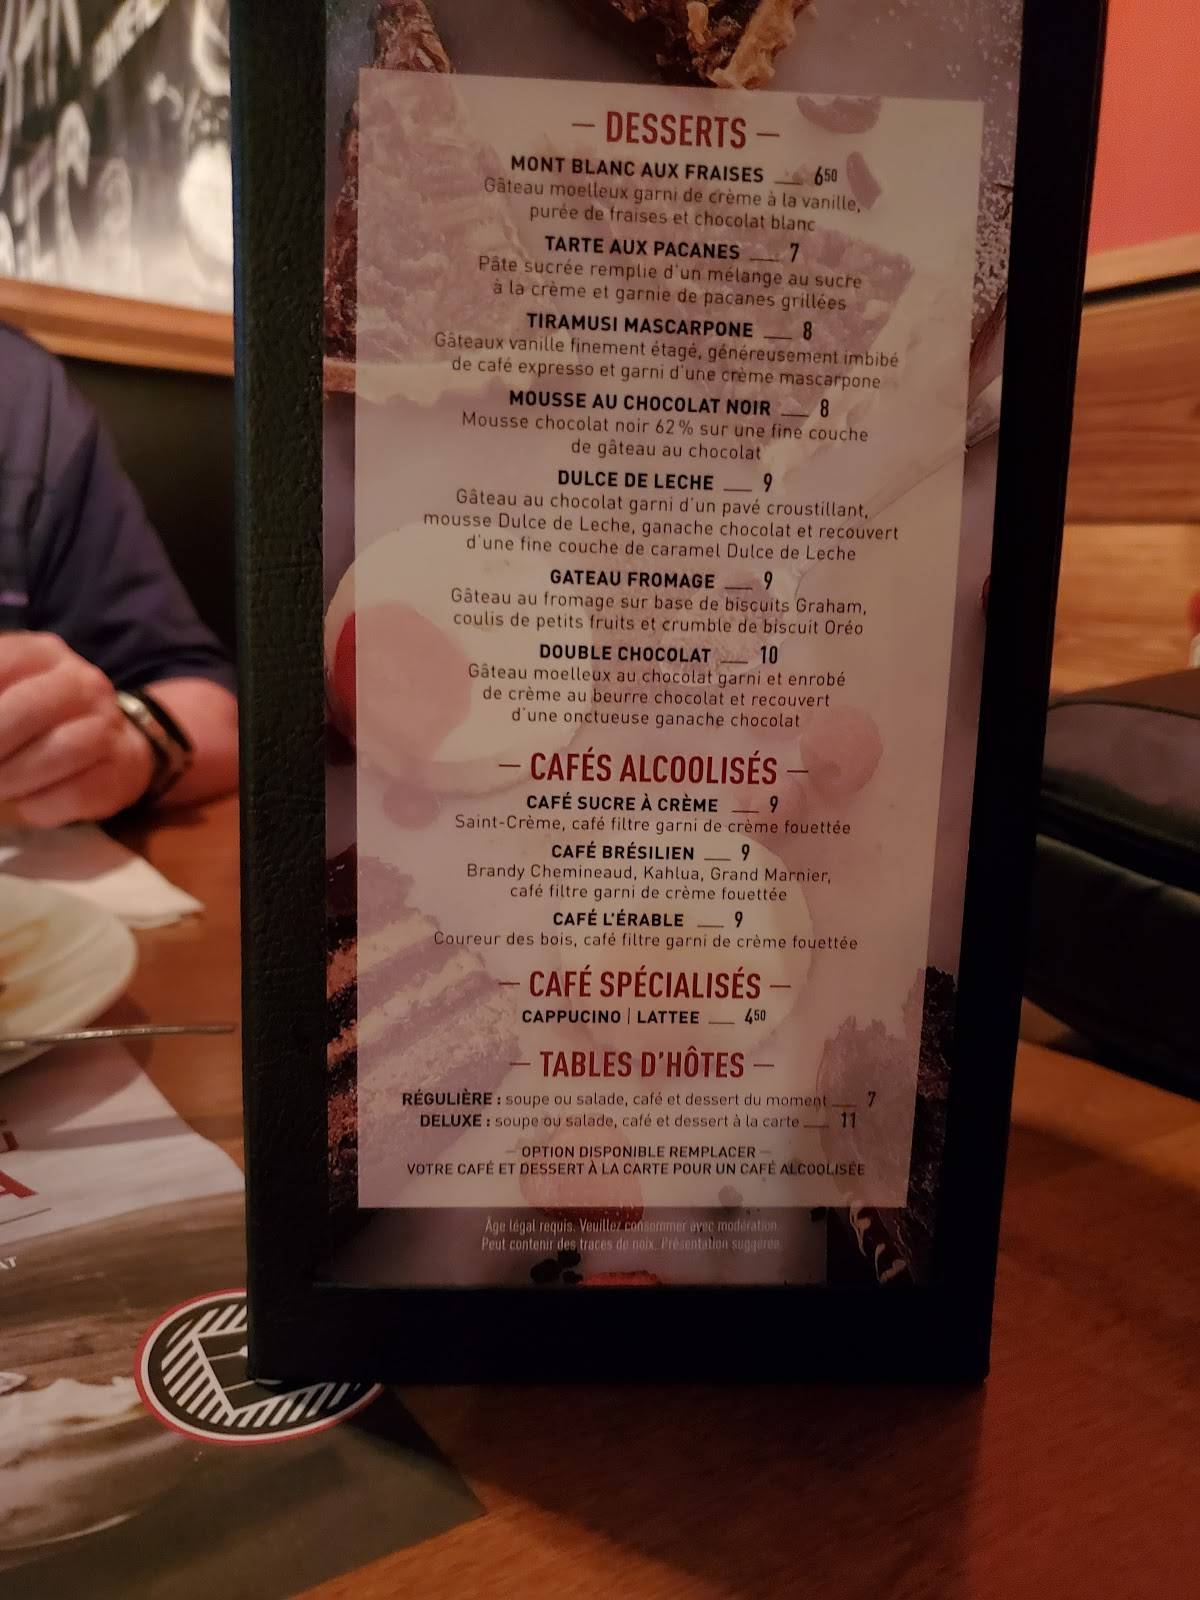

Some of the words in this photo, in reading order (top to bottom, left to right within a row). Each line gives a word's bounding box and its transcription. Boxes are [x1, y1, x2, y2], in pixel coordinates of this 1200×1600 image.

[605, 111, 748, 150] DESSERTS
[510, 155, 566, 174] MONT
[571, 158, 636, 178] BLANC
[641, 161, 679, 180] AUX
[685, 164, 765, 184] FRAISES
[479, 175, 544, 195] Gâteau
[549, 181, 629, 200] moelleux
[631, 187, 678, 205] garni
[682, 186, 703, 203] de
[708, 188, 762, 207] crème
[767, 190, 777, 207] à
[782, 191, 797, 209] la
[801, 194, 861, 213] vanille,
[544, 235, 606, 255] TARTE
[609, 239, 648, 257] AUX
[653, 241, 741, 261] PACANES
[789, 243, 801, 263] 7
[477, 254, 520, 273] Pâte
[523, 258, 584, 277] sucrée
[590, 263, 658, 281] remplie
[663, 264, 702, 280] d'un
[707, 267, 783, 288] mélange
[787, 272, 809, 287] au
[814, 274, 863, 290] sucre
[529, 312, 618, 332] TIRAMUSI
[624, 317, 754, 338] MASCARPONE
[802, 320, 813, 341] 8
[434, 330, 504, 350] Gâteaux
[508, 336, 565, 353] vanille
[570, 337, 646, 356] finement
[650, 341, 703, 362] étagé,
[707, 344, 839, 364] généreusement
[843, 351, 899, 368] imbibé
[507, 390, 587, 408] MOUSSE
[591, 392, 618, 410] AU
[623, 395, 721, 414] CHOCOLAT
[725, 398, 772, 416] NOIR
[820, 397, 830, 419] 8
[557, 470, 619, 487] DULCE
[623, 472, 649, 489] DE
[653, 474, 715, 491] LECHE
[763, 471, 773, 493] 9
[456, 488, 517, 506] Gâteau
[523, 494, 544, 508] au
[550, 492, 623, 510] chocolat
[628, 497, 673, 515] garni
[679, 496, 716, 514] d'un
[722, 499, 761, 517] pavé
[766, 501, 869, 518] croustillant,
[550, 569, 621, 586] GATEAU
[627, 573, 716, 590] FROMAGE
[763, 569, 773, 591] 9
[453, 610, 504, 627] coulis
[510, 611, 530, 628] de
[536, 614, 584, 631] petits
[589, 614, 635, 631] fruits
[640, 617, 656, 631] et
[661, 617, 732, 633] crumble
[737, 617, 758, 634] de
[762, 617, 819, 635] biscuit
[824, 619, 864, 636] Oréo
[539, 643, 612, 660] DOUBLE
[617, 645, 712, 663] CHOCOLAT
[760, 644, 778, 665] 10
[468, 662, 527, 680] Gâteau
[533, 666, 611, 682] moelleux
[616, 671, 636, 683] au
[641, 668, 713, 685] chocolat
[718, 672, 761, 689] garni
[766, 672, 782, 686] et
[788, 671, 846, 687] enrobé
[511, 706, 558, 723] d'une
[563, 710, 649, 725] onctueuse
[655, 712, 725, 729] ganache
[730, 713, 801, 729] chocolat
[530, 746, 612, 782] CAFÉS
[619, 750, 778, 785] ALCOOLISÉS
[526, 792, 573, 810] CAFÉ
[577, 795, 636, 812] SUCRE
[640, 791, 653, 812] À
[657, 794, 719, 813] CRÈME
[769, 794, 779, 813] 9
[551, 841, 597, 859] CAFÉ
[602, 842, 695, 861] BRÉSILIEN
[741, 842, 751, 861] 9
[467, 863, 525, 880] Brandy
[530, 863, 637, 880] Chemineaud,
[643, 865, 704, 881] Kahlua,
[710, 866, 759, 882] Grand
[764, 867, 831, 883] Marnier,
[552, 908, 598, 926] CAFÉ
[603, 909, 684, 928] L'ÉRABLE
[734, 909, 744, 928] 9
[434, 930, 501, 946] Coureur
[506, 932, 535, 946] des
[540, 931, 577, 947] bois,
[583, 931, 616, 947] café
[622, 931, 660, 948] filtre
[665, 935, 707, 951] garni
[712, 934, 731, 948] de
[736, 934, 787, 949] crème
[792, 935, 858, 950] fouettée
[529, 964, 592, 998] CAFÉ
[599, 965, 762, 999] SPÉCIALISÉS
[521, 1009, 622, 1024] CAPPUCINO
[637, 1010, 700, 1025] LATTEE
[540, 1051, 633, 1078] TABLES
[640, 1045, 745, 1078] D'HÔTES
[420, 1113, 483, 1128] DELUXE
[495, 1116, 539, 1130] soupe
[543, 1116, 561, 1128] ou
[565, 1114, 618, 1128] salade,
[622, 1112, 652, 1128] café
[656, 1114, 670, 1128] et
[674, 1113, 729, 1128] dessert
[732, 1114, 742, 1128] à
[745, 1113, 759, 1128] la
[762, 1116, 800, 1128] carte
[841, 1111, 856, 1129] 11
[521, 1145, 575, 1159] OPTION
[579, 1145, 665, 1159] DISPONIBLE
[669, 1145, 756, 1159] REMPLACER
[406, 1162, 453, 1175] VOTRE
[457, 1160, 495, 1176] CAFÉ
[498, 1162, 515, 1175] ET
[519, 1162, 585, 1175] DESSERT
[587, 1159, 598, 1175] À
[601, 1162, 620, 1176] LA
[623, 1162, 669, 1175] CARTE
[672, 1162, 712, 1175] POUR
[715, 1162, 736, 1175] UN
[740, 1161, 775, 1175] CAFÉ
[779, 1161, 866, 1176] ALCOOLISÉE
